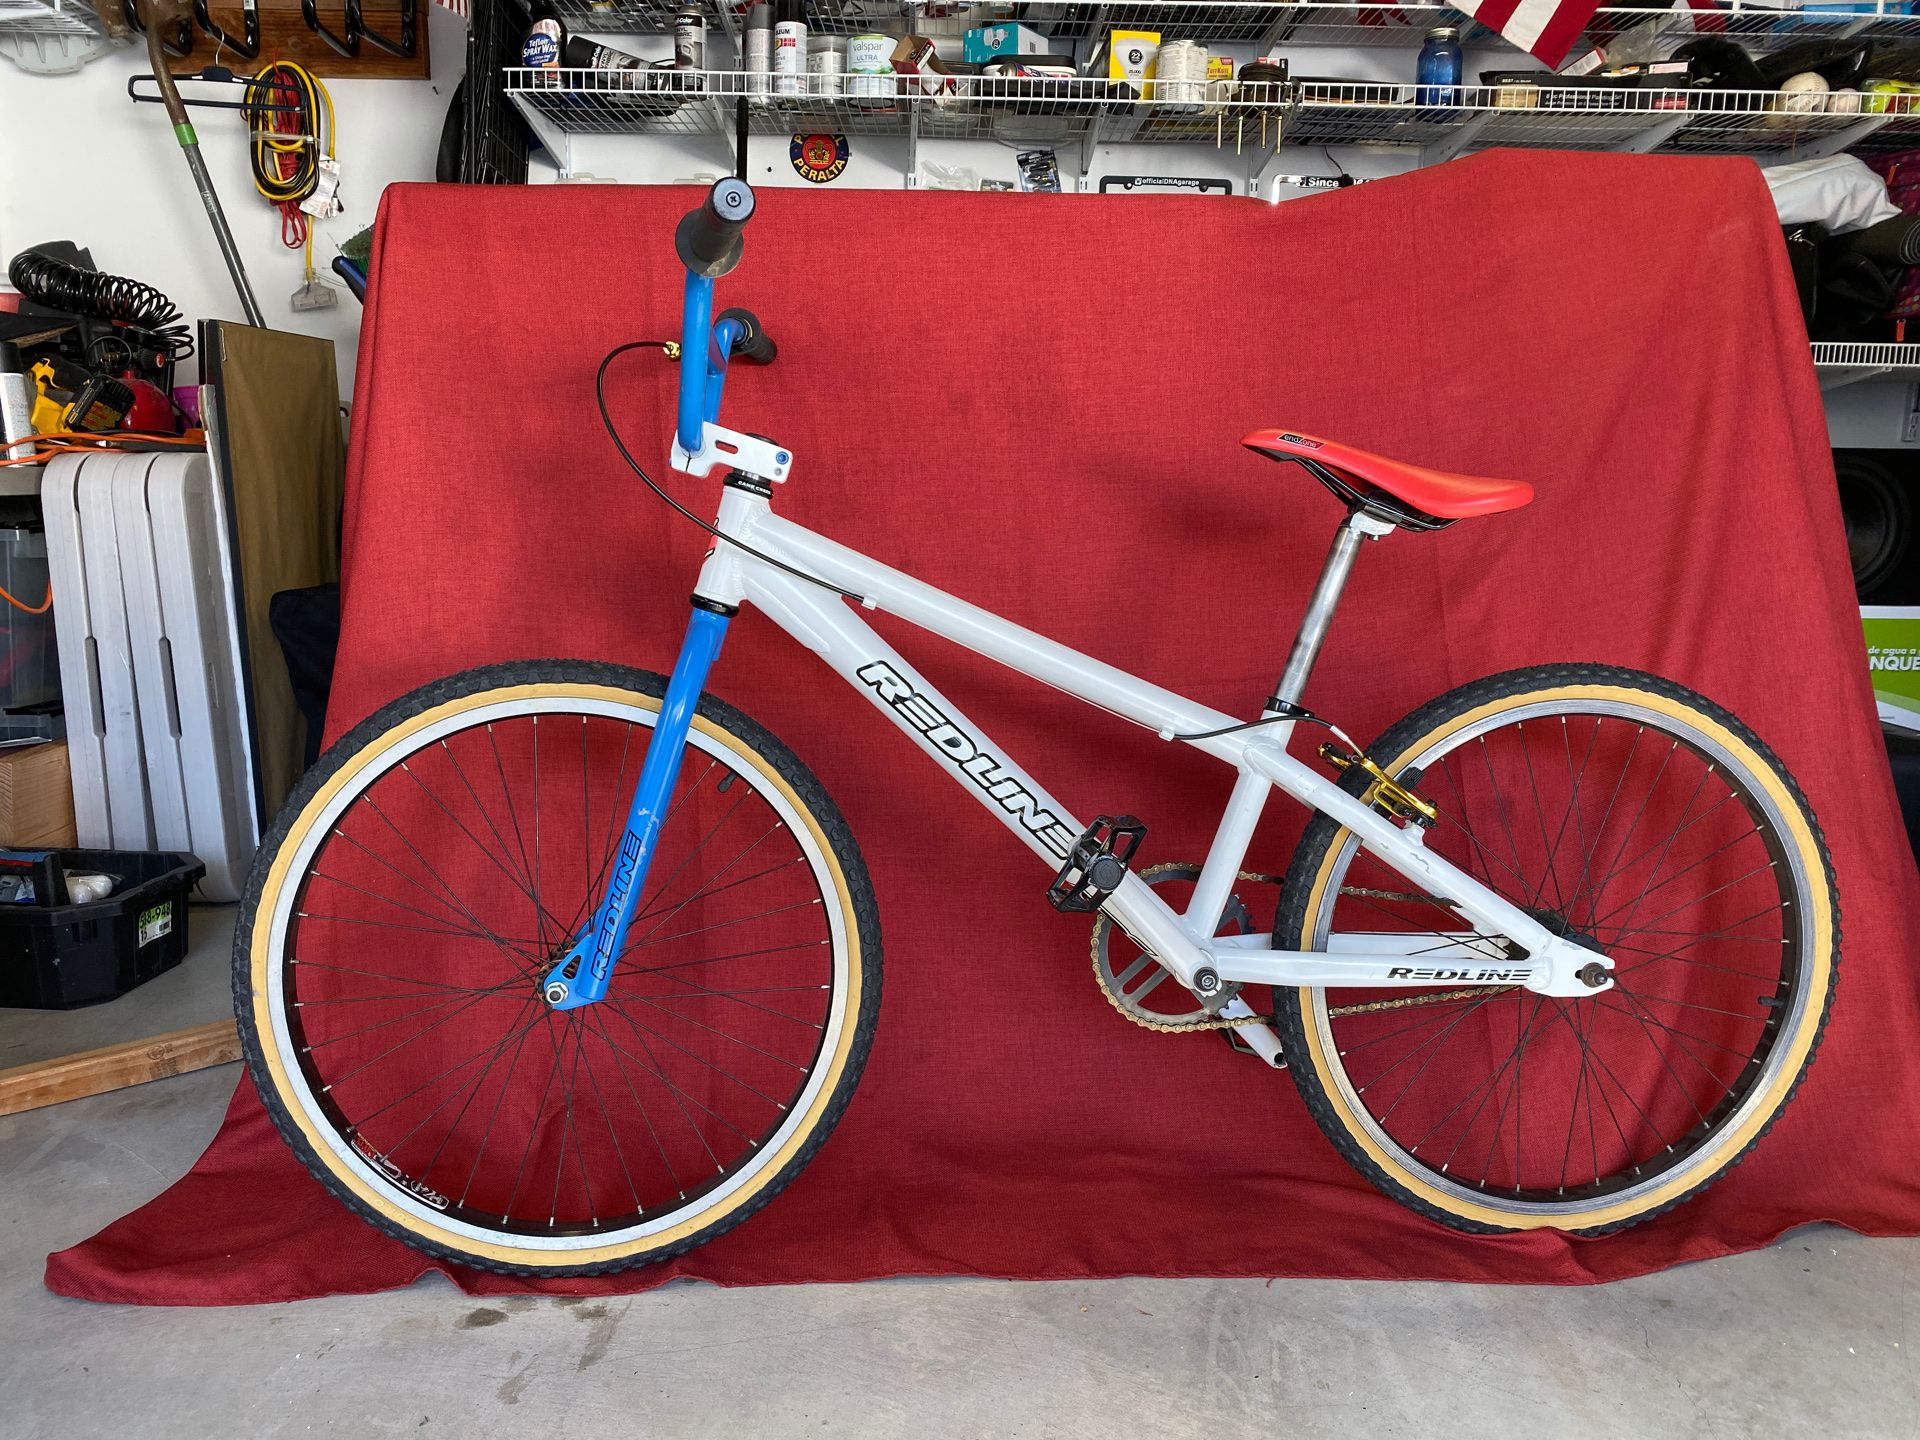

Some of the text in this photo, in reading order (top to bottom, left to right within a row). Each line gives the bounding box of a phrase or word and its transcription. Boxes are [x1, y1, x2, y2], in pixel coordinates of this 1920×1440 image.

[522, 43, 558, 58] SPRAY WAX
[853, 41, 884, 53] valspar
[793, 158, 846, 181] PERALTA
[1142, 178, 1200, 188] officialDNAgarage
[1308, 177, 1339, 188] Since
[1868, 645, 1880, 655] de
[1883, 648, 1906, 656] agua
[856, 660, 1077, 861] REDLINE
[591, 829, 641, 981] REDLINE
[1387, 967, 1533, 981] REDLINE
